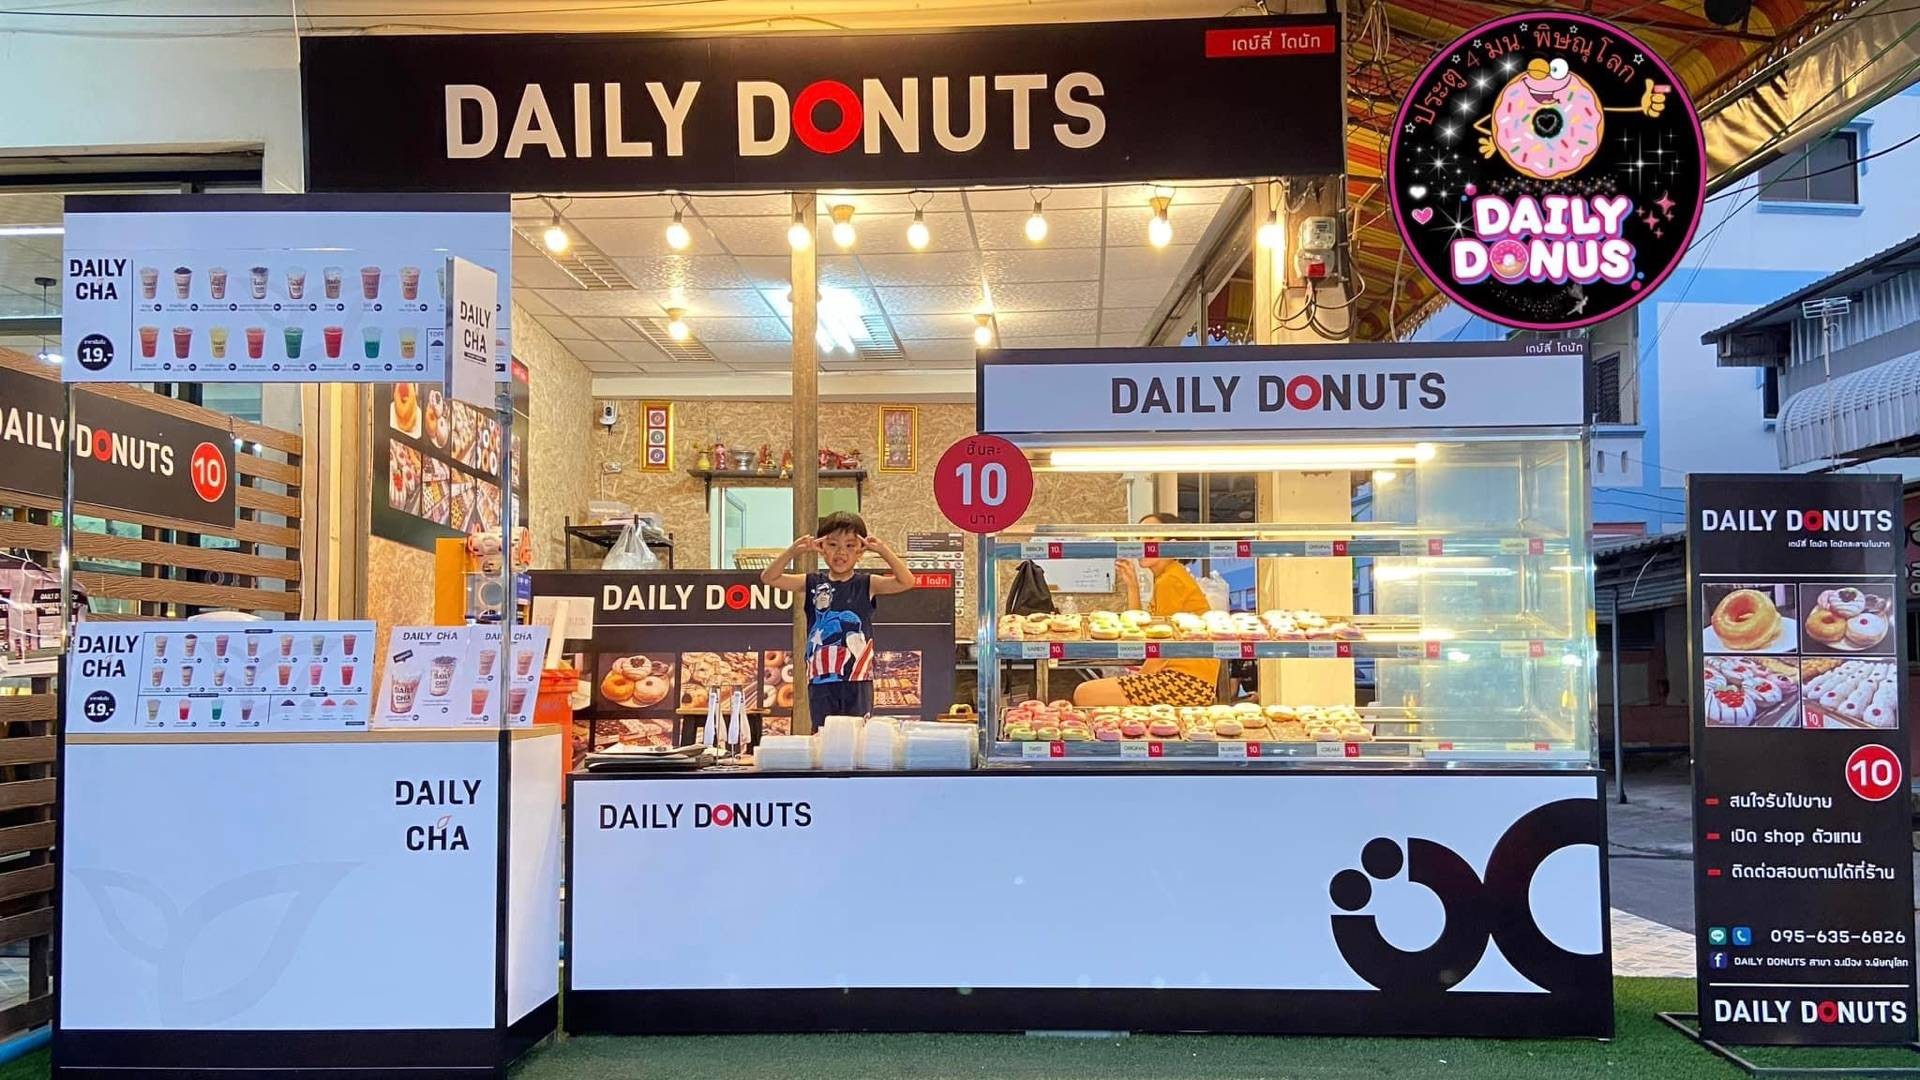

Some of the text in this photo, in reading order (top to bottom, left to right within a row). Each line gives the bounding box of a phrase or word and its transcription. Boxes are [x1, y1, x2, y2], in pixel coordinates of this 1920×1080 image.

[1281, 33, 1320, 49] โดนัท
[444, 71, 1107, 160] DAILY DONUTS
[69, 258, 127, 277] DAILY
[75, 281, 118, 300] CHA
[460, 300, 491, 329] DAILY
[464, 328, 487, 354] CHA
[1556, 342, 1584, 353] โดนัท
[82, 347, 114, 363] 19.-
[1111, 371, 1447, 414] DAILY DONUTS
[0, 406, 174, 477] AILY DONUTS
[966, 441, 1001, 456] ชิ้นละ
[194, 456, 221, 488] 10
[955, 462, 1008, 506] 10
[969, 513, 996, 525] บาท
[1702, 509, 1893, 532] DAILY DONUTS
[602, 583, 793, 611] DAILY DONU
[78, 635, 140, 654] DAILY
[402, 631, 459, 641] DAILY CHA
[513, 632, 532, 641] CHA
[82, 659, 127, 678] CHA
[87, 703, 114, 717] 19.-
[1851, 759, 1893, 787] 10
[396, 780, 482, 805] DAILY
[1730, 791, 1833, 809] สนใจรับไปขาย
[600, 801, 813, 830] DAILY DONUTS
[406, 825, 470, 851] CHA
[1730, 828, 1862, 846] เปิด shop ตัวแทน
[1731, 861, 1895, 880] ติดต่อสอบถามได้ที่ร้าน
[1770, 929, 1906, 944] 095-635-6826
[1734, 957, 1763, 967] DAILY
[1766, 957, 1806, 967] DONUTS
[1714, 999, 1907, 1024] DAILY DONUTS
